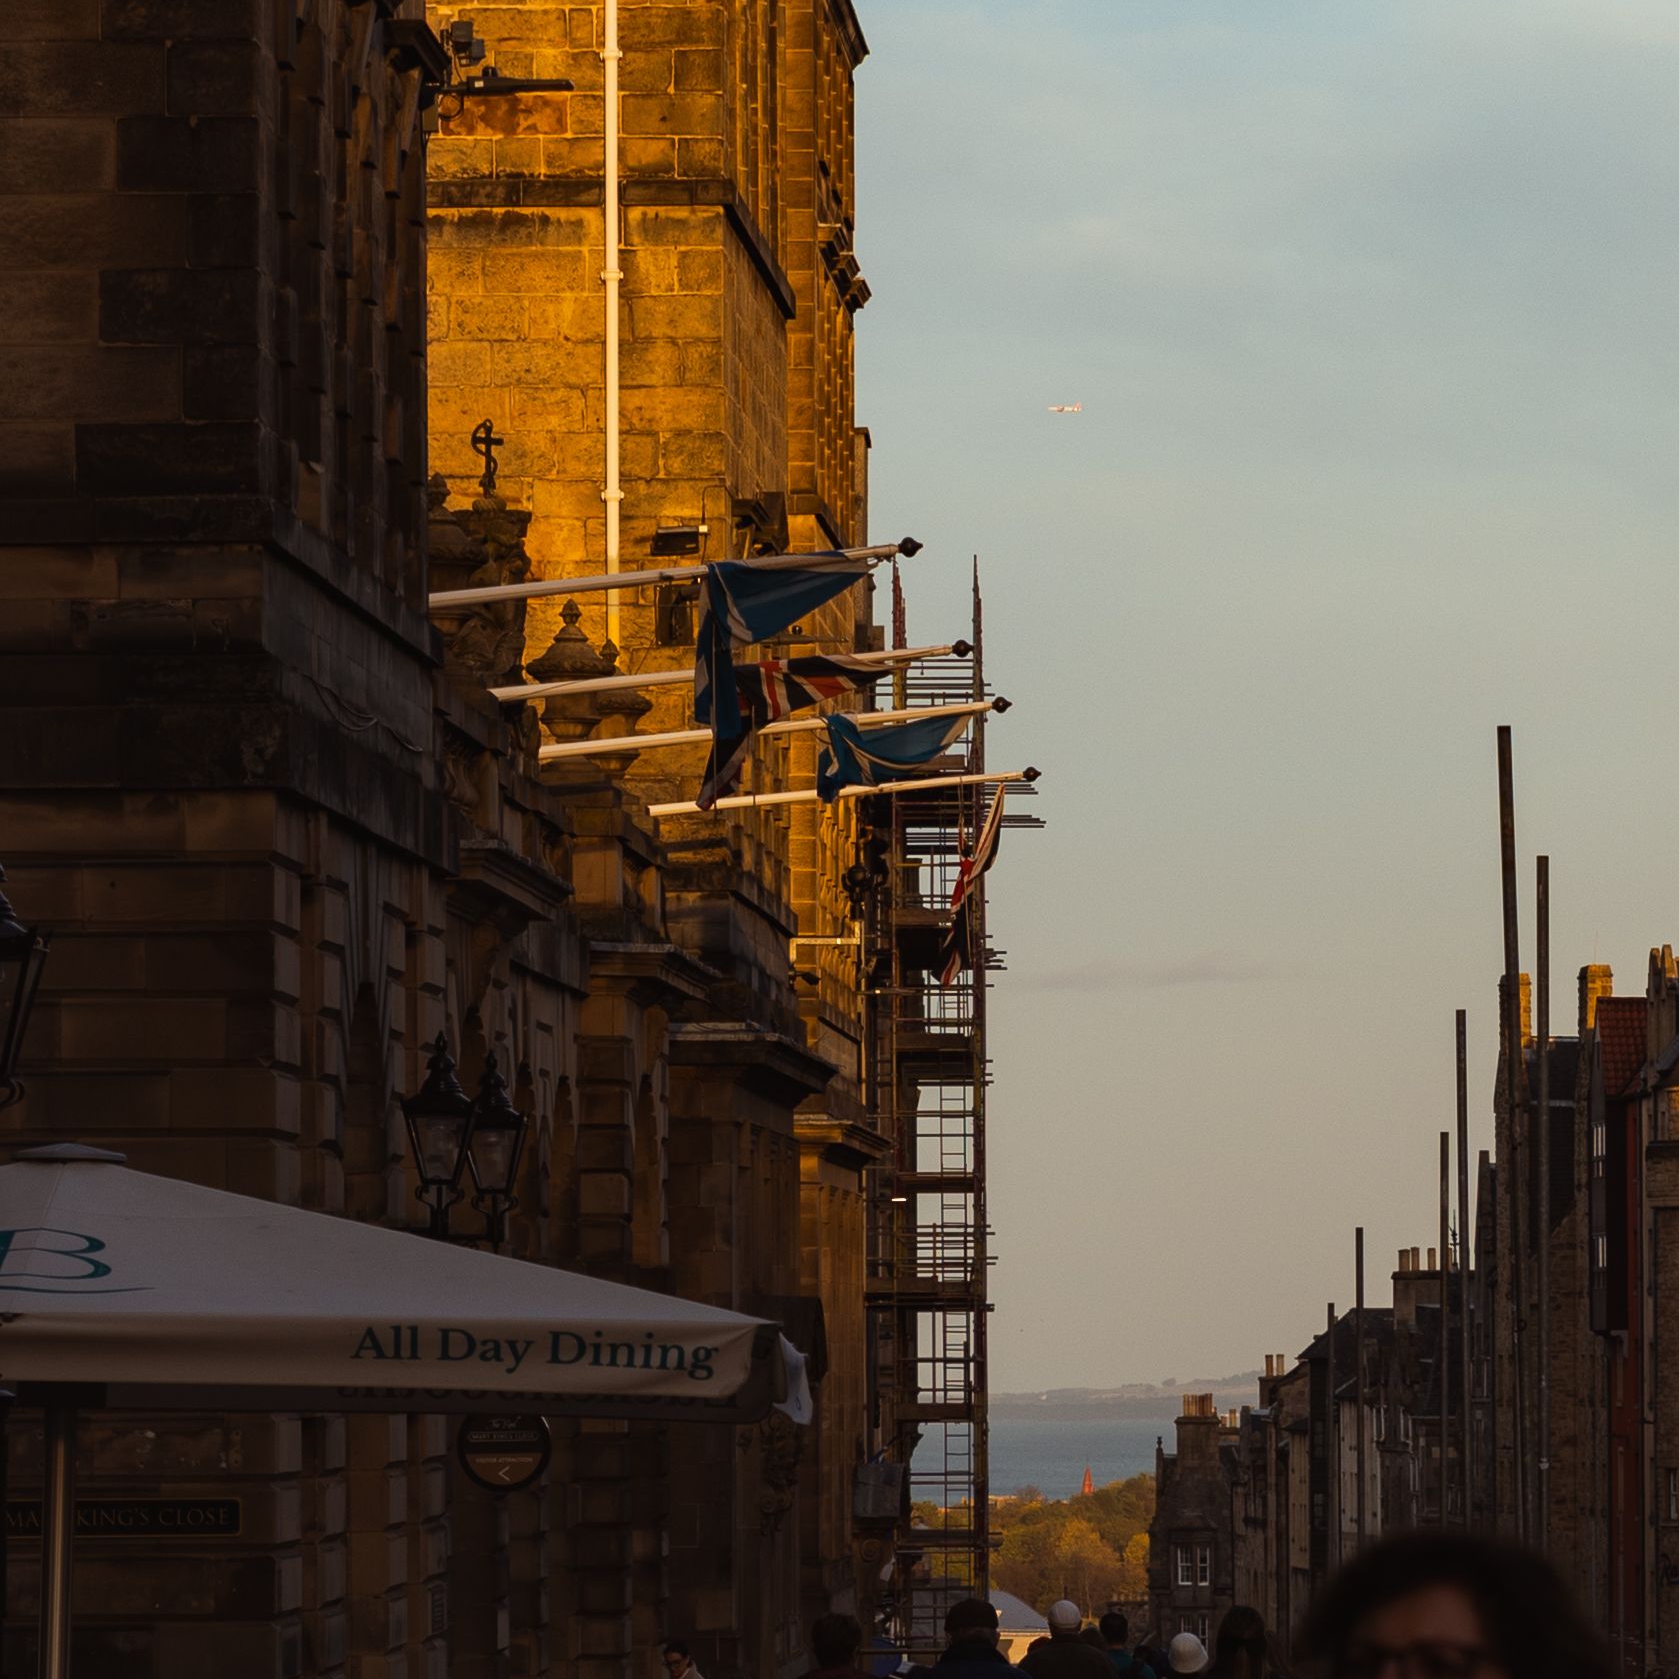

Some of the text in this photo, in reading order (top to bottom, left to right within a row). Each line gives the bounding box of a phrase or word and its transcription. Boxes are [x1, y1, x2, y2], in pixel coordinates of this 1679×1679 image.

[350, 1326, 720, 1381] All Day Dining
[77, 1508, 151, 1527] KING'S
[159, 1508, 230, 1527] CLOSE
